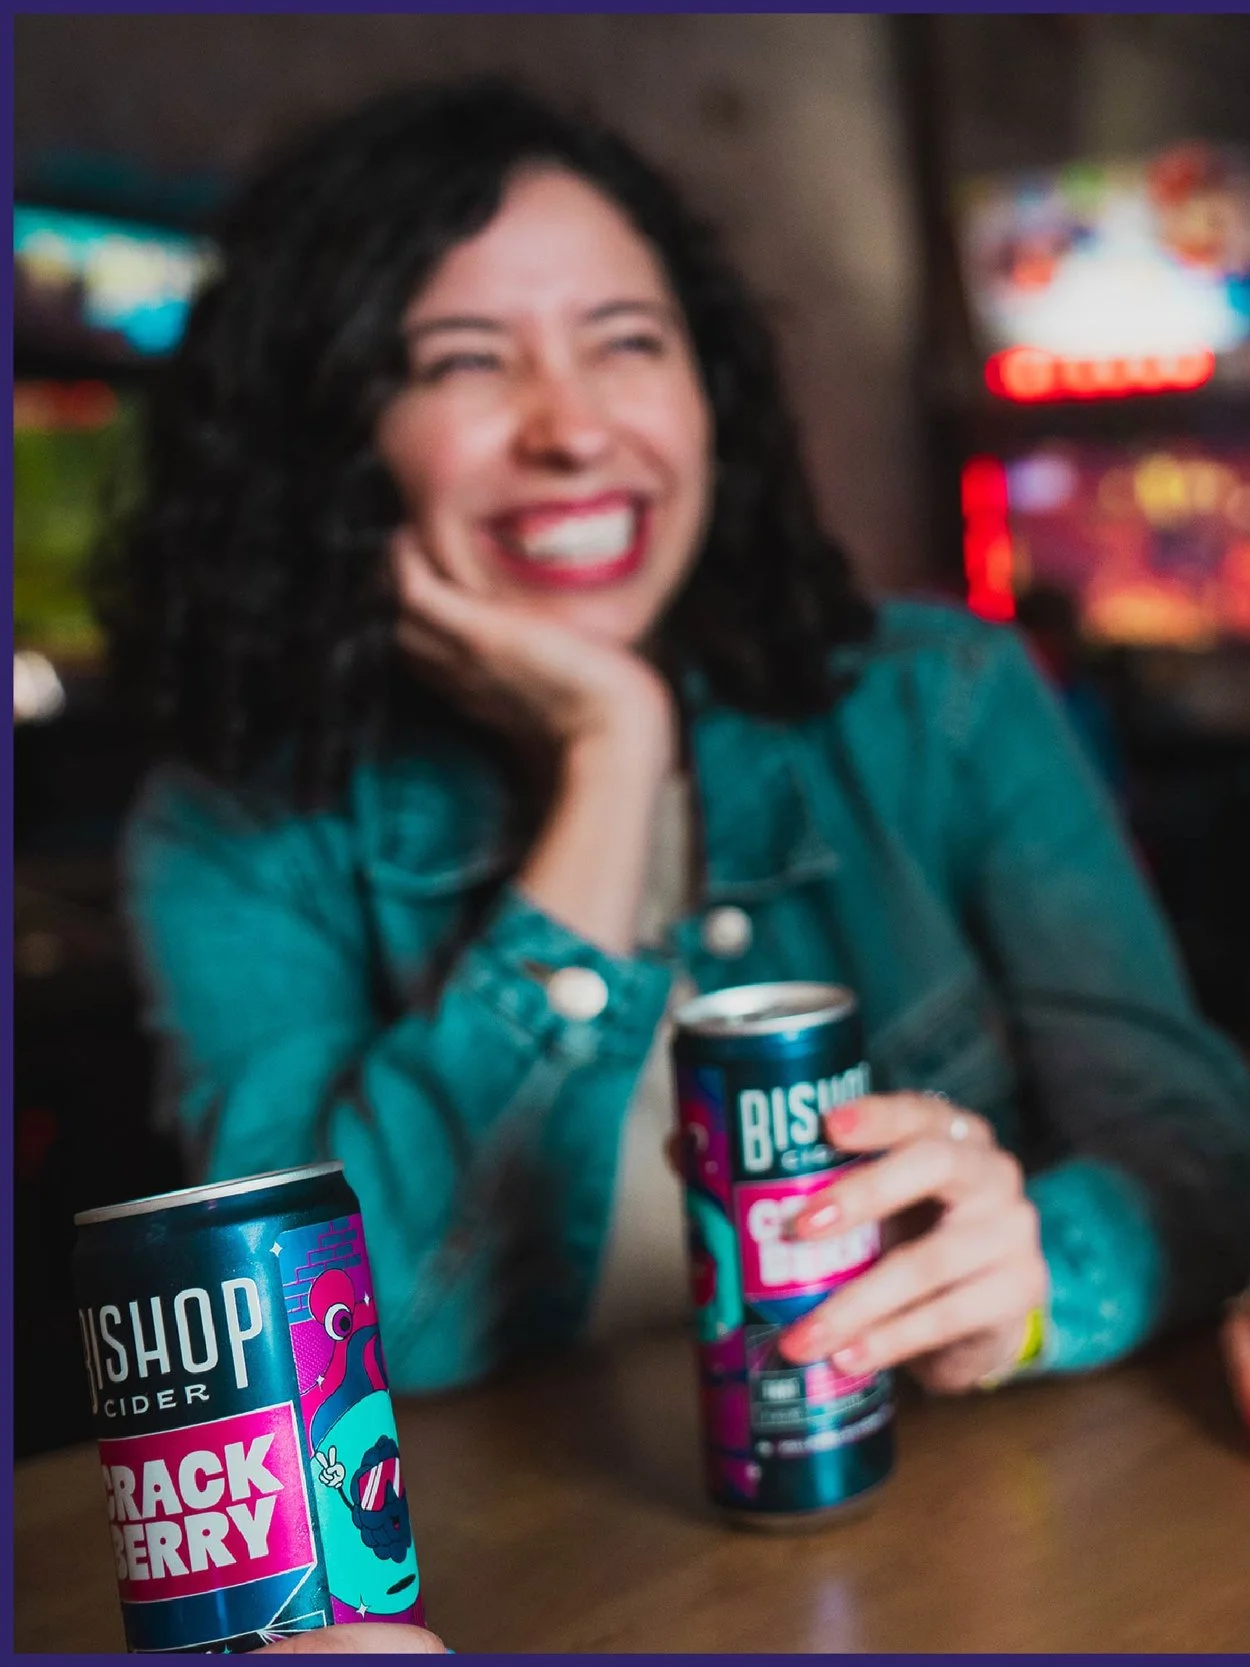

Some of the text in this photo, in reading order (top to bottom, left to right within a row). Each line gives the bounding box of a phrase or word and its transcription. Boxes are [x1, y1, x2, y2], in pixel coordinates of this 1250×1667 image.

[739, 1061, 872, 1172] BIS
[103, 1383, 210, 1418] CIDER
[110, 1494, 277, 1581] BERRY
